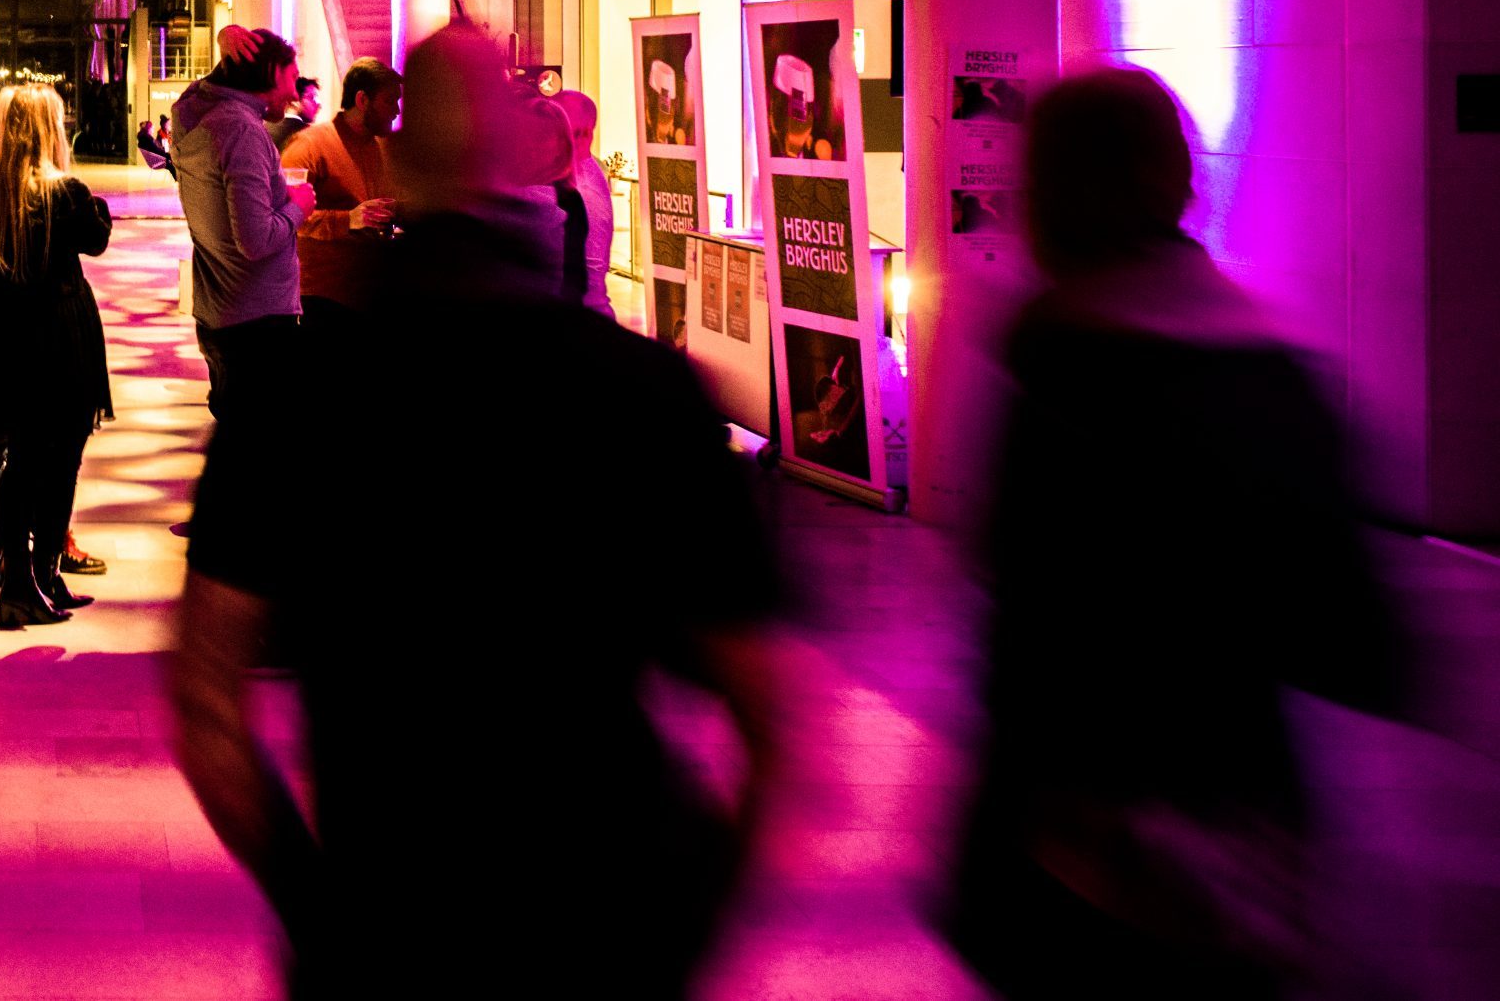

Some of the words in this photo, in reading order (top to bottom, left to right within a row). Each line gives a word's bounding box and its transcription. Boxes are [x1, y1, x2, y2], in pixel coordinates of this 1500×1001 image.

[965, 50, 1019, 63] HERSLEV
[965, 62, 1018, 74] BRYGHUS
[654, 191, 693, 214] HERSLEV
[783, 217, 845, 247] HERSLEV
[785, 245, 848, 275] BRYGHUS
